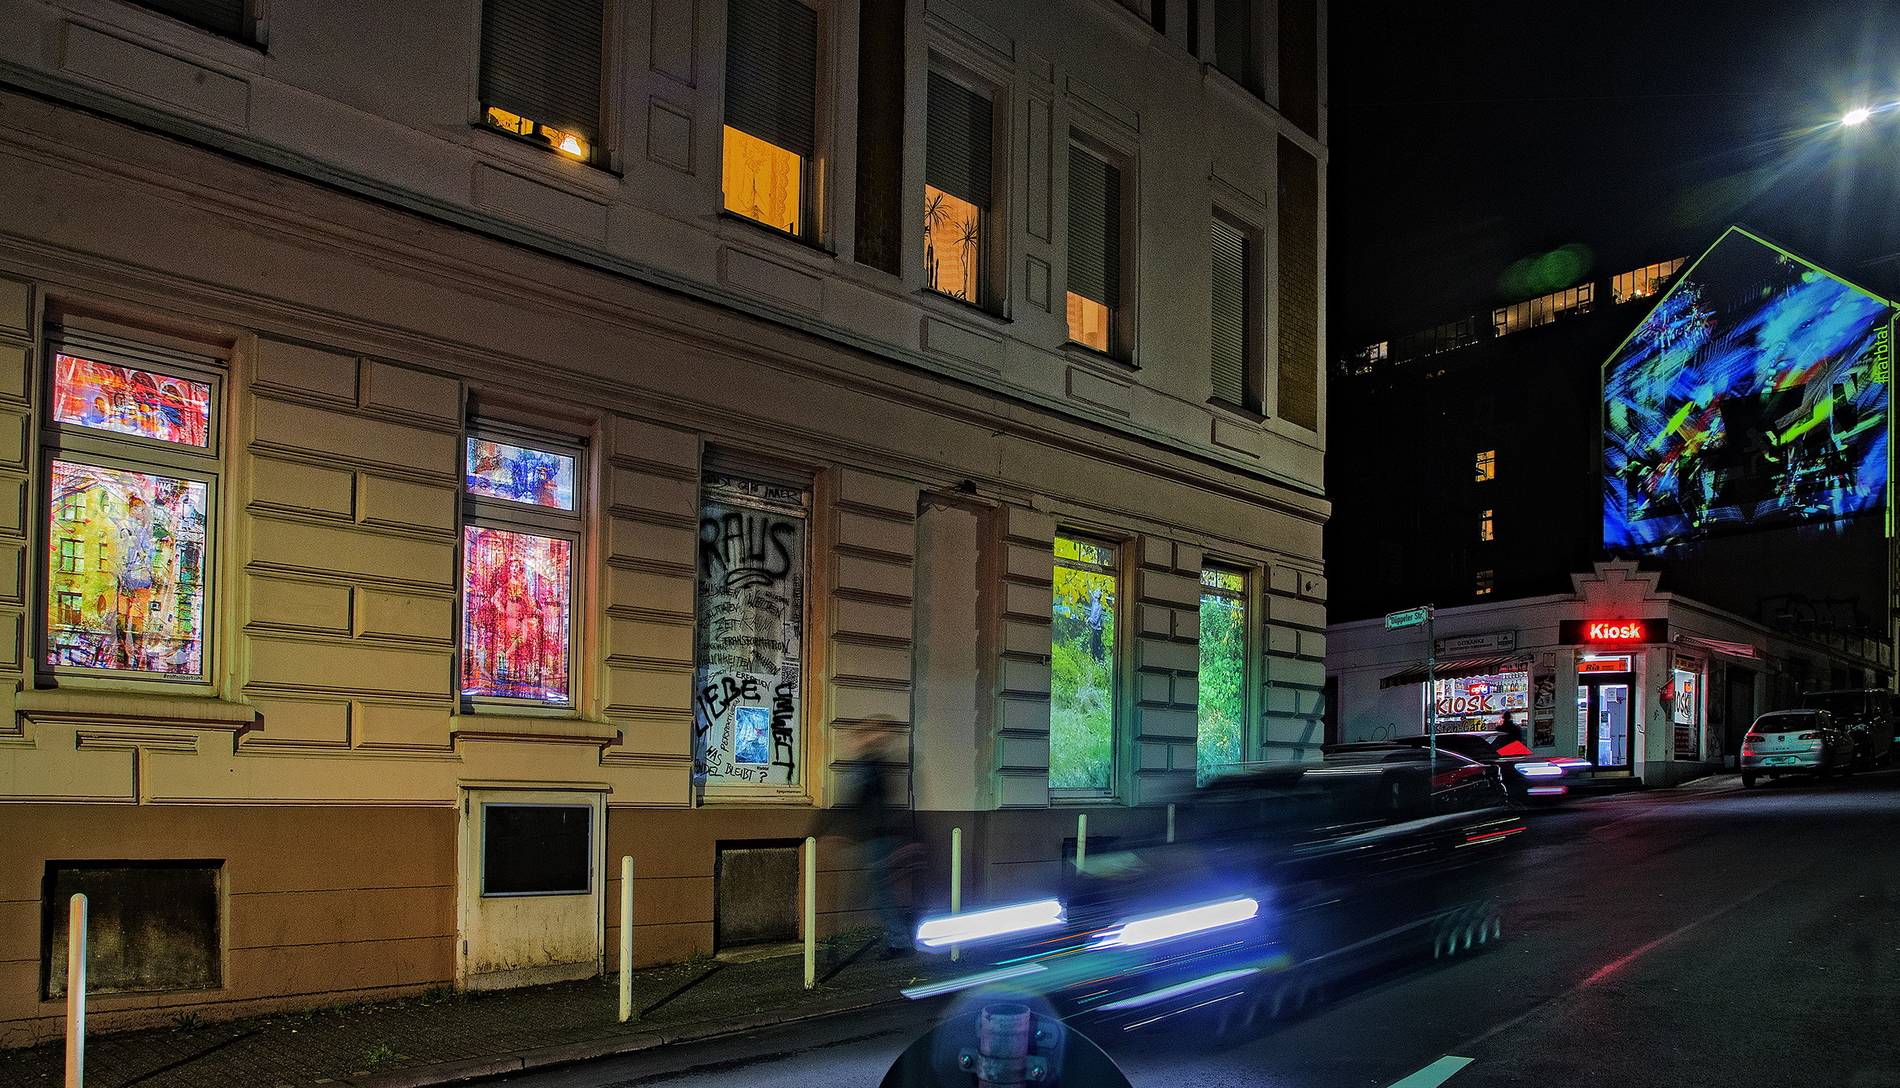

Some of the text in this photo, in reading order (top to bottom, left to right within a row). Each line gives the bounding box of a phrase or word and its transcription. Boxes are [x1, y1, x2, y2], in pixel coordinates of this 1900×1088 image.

[700, 512, 794, 578] RAUS
[1590, 623, 1641, 639] Kiosk
[695, 677, 761, 738] LIEBE
[1436, 694, 1493, 715] KIOSK
[705, 745, 722, 766] WAS
[725, 763, 756, 781] BLEIBT
